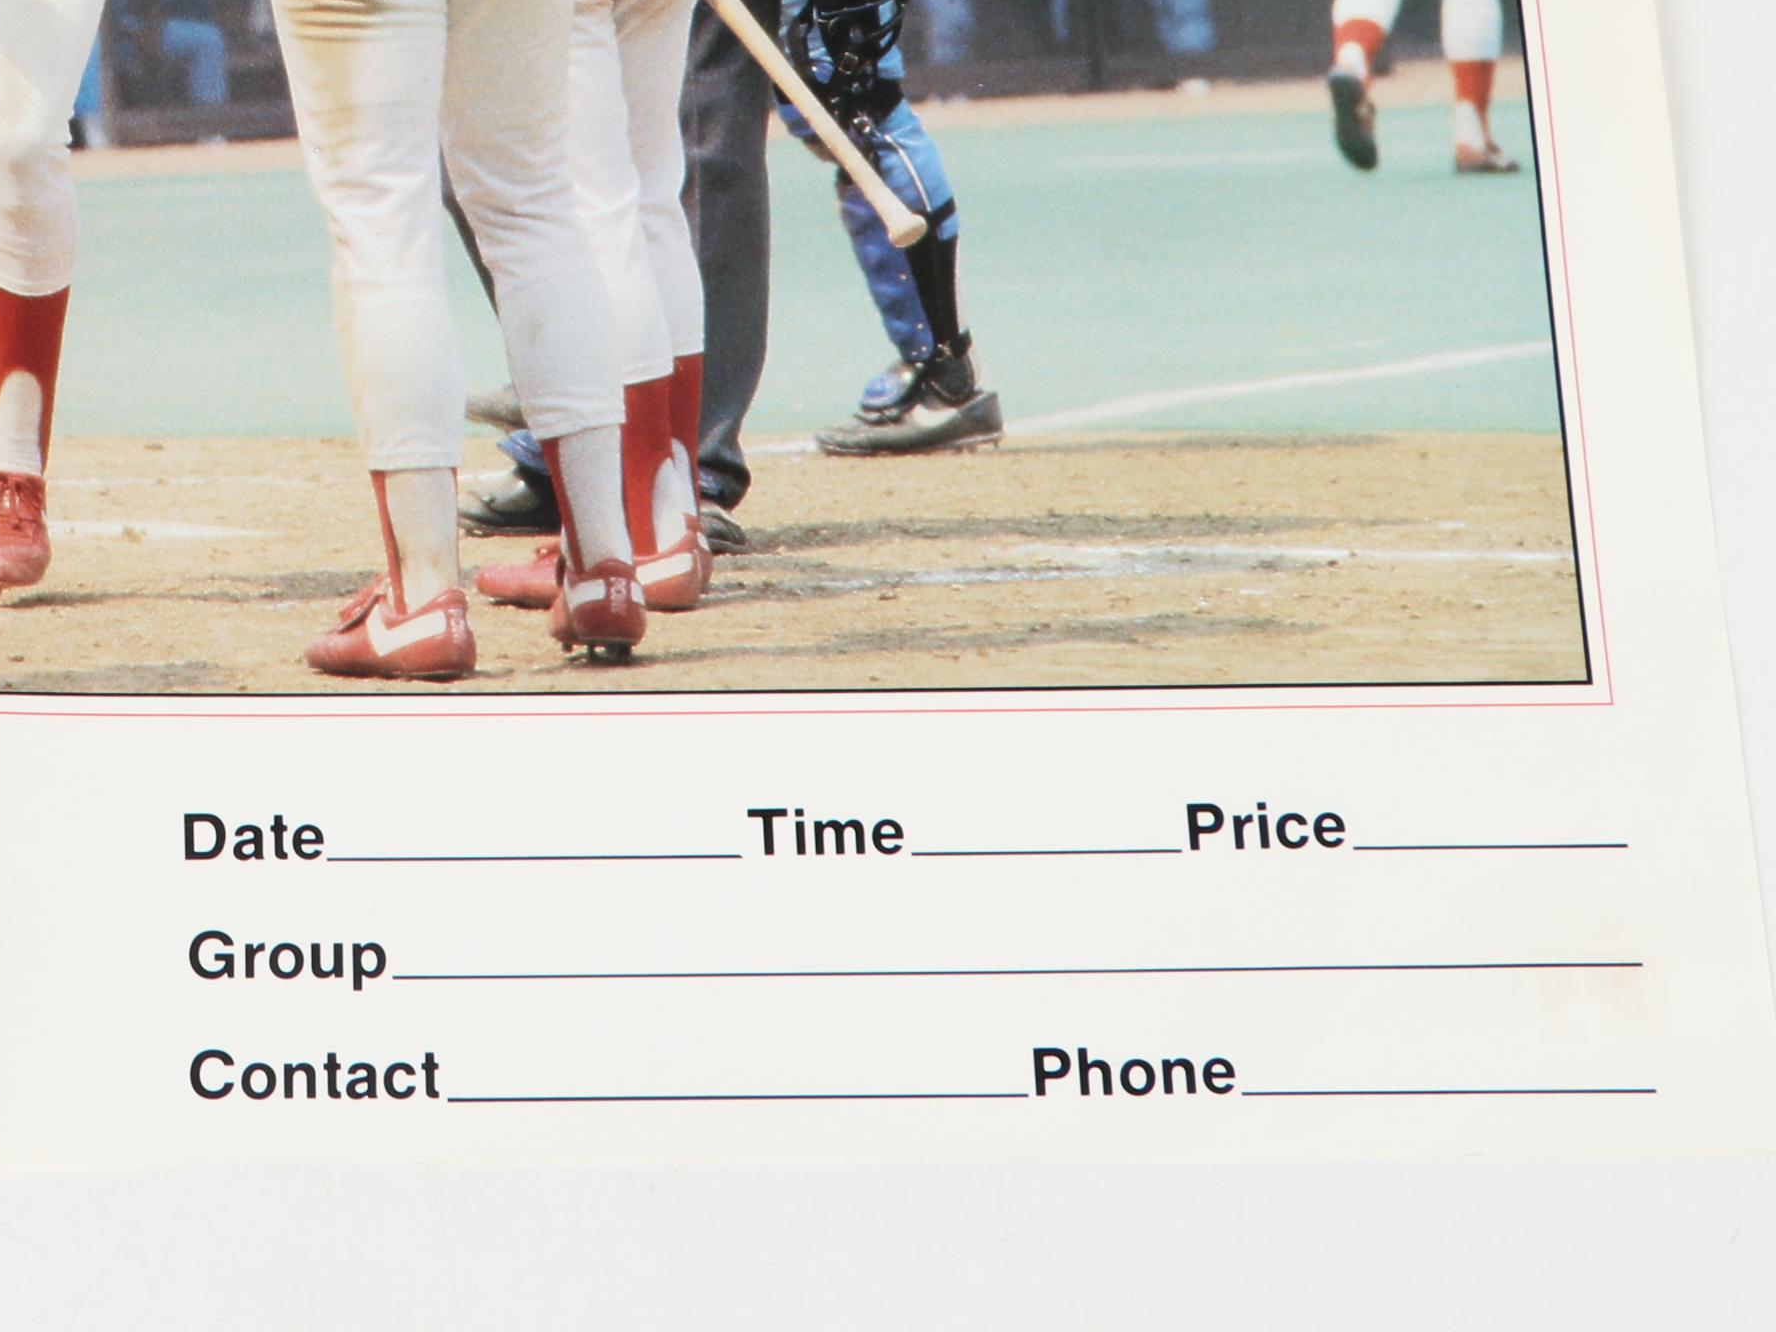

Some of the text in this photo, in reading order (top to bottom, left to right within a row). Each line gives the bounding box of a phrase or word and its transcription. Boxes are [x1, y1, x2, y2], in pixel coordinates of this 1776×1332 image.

[182, 801, 1346, 862] Date Time Price
[187, 930, 388, 991] Group
[188, 1046, 1237, 1100] Contact Phone
